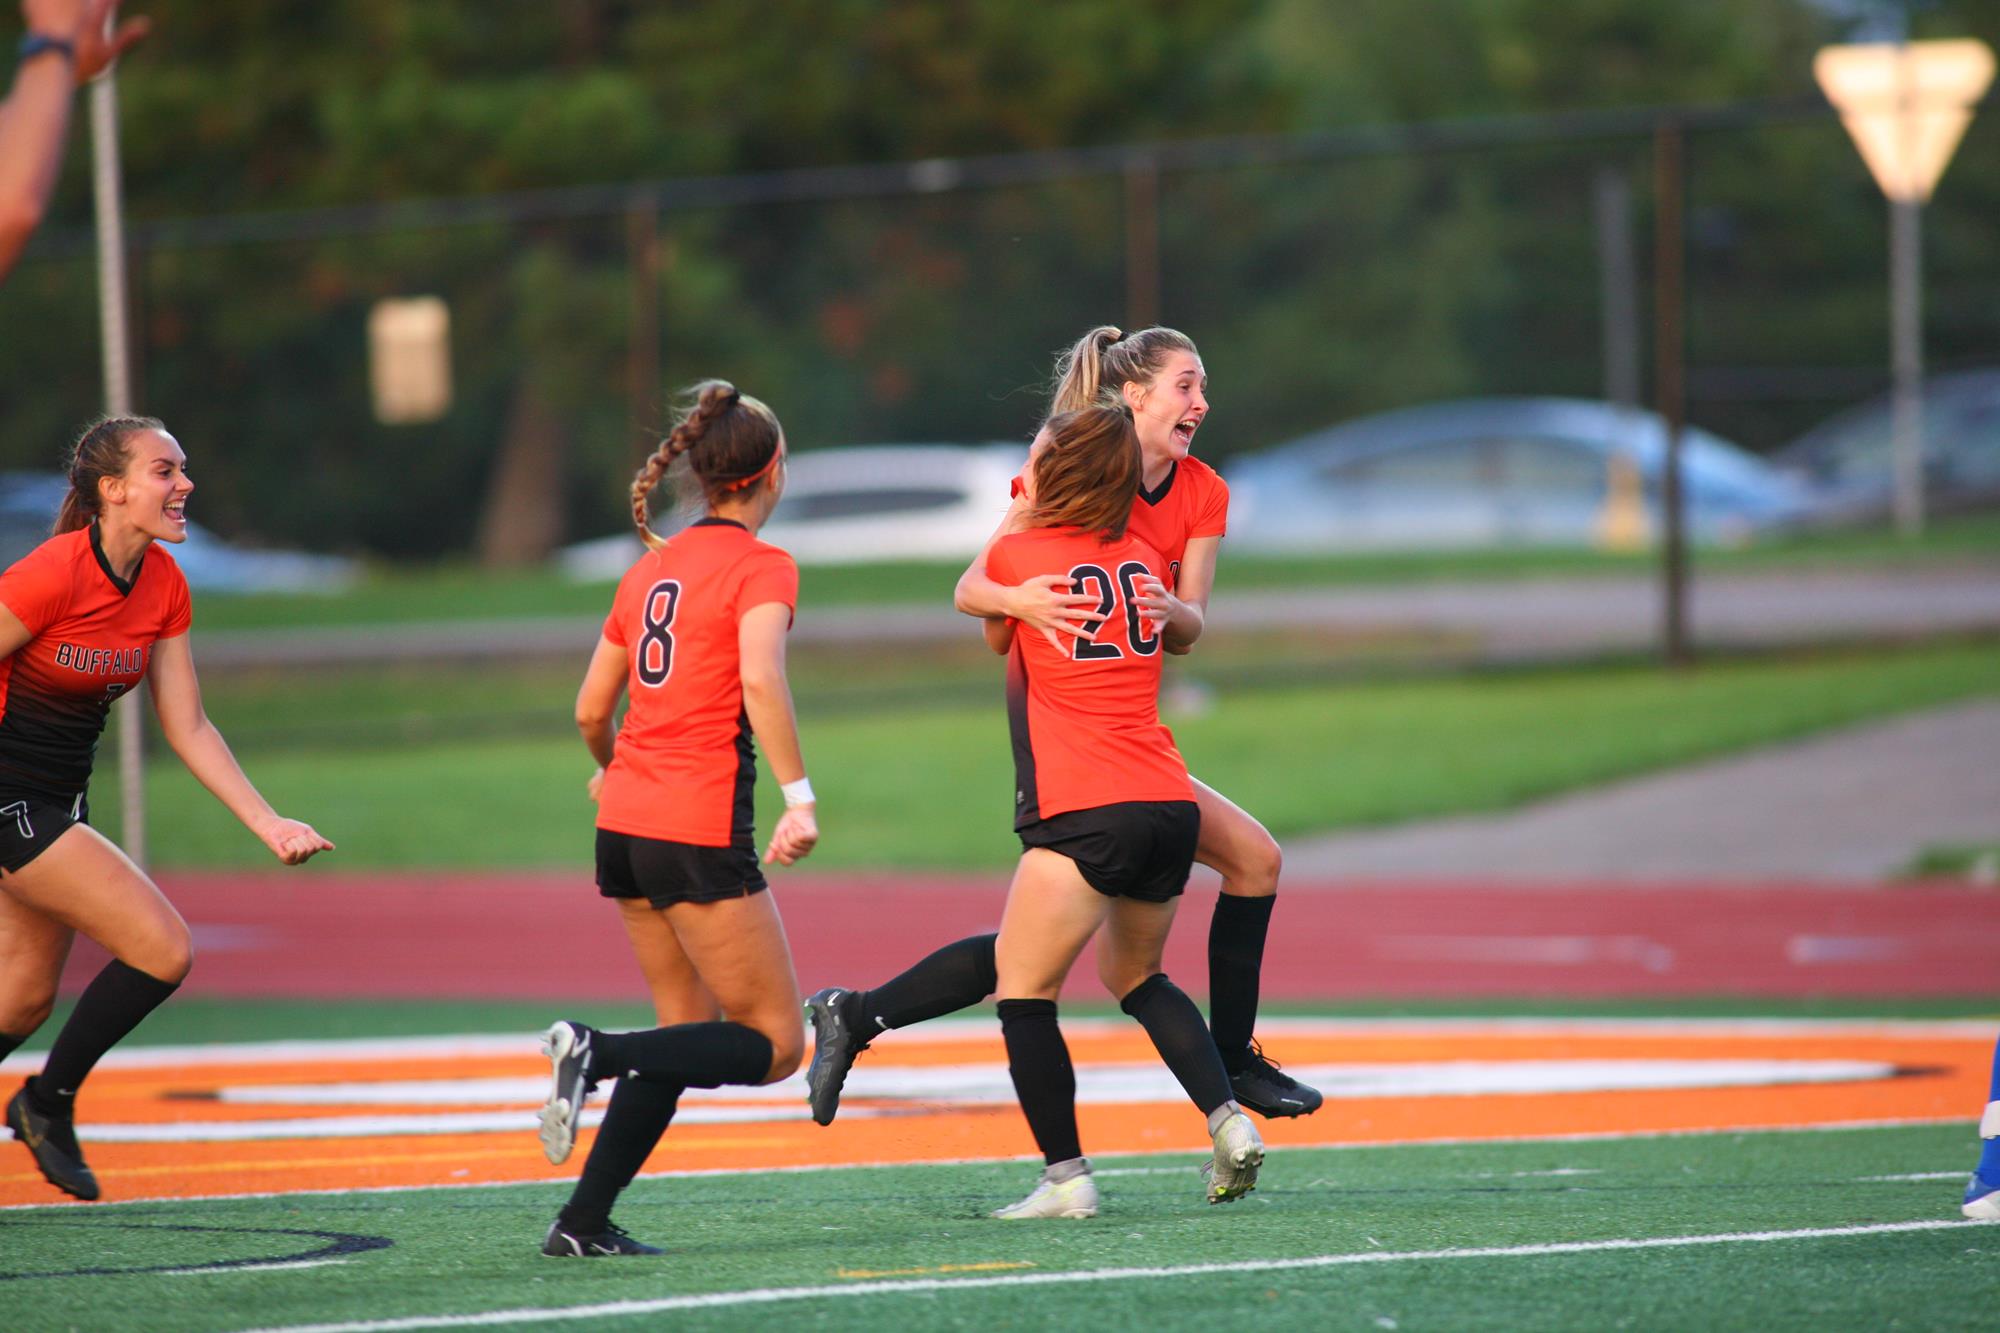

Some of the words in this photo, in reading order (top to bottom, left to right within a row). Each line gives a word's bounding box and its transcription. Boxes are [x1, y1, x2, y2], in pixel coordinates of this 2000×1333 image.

[636, 579, 681, 688] 8
[1068, 561, 1160, 660] 20
[55, 643, 142, 675] BUFFALO
[0, 800, 34, 838] 7
